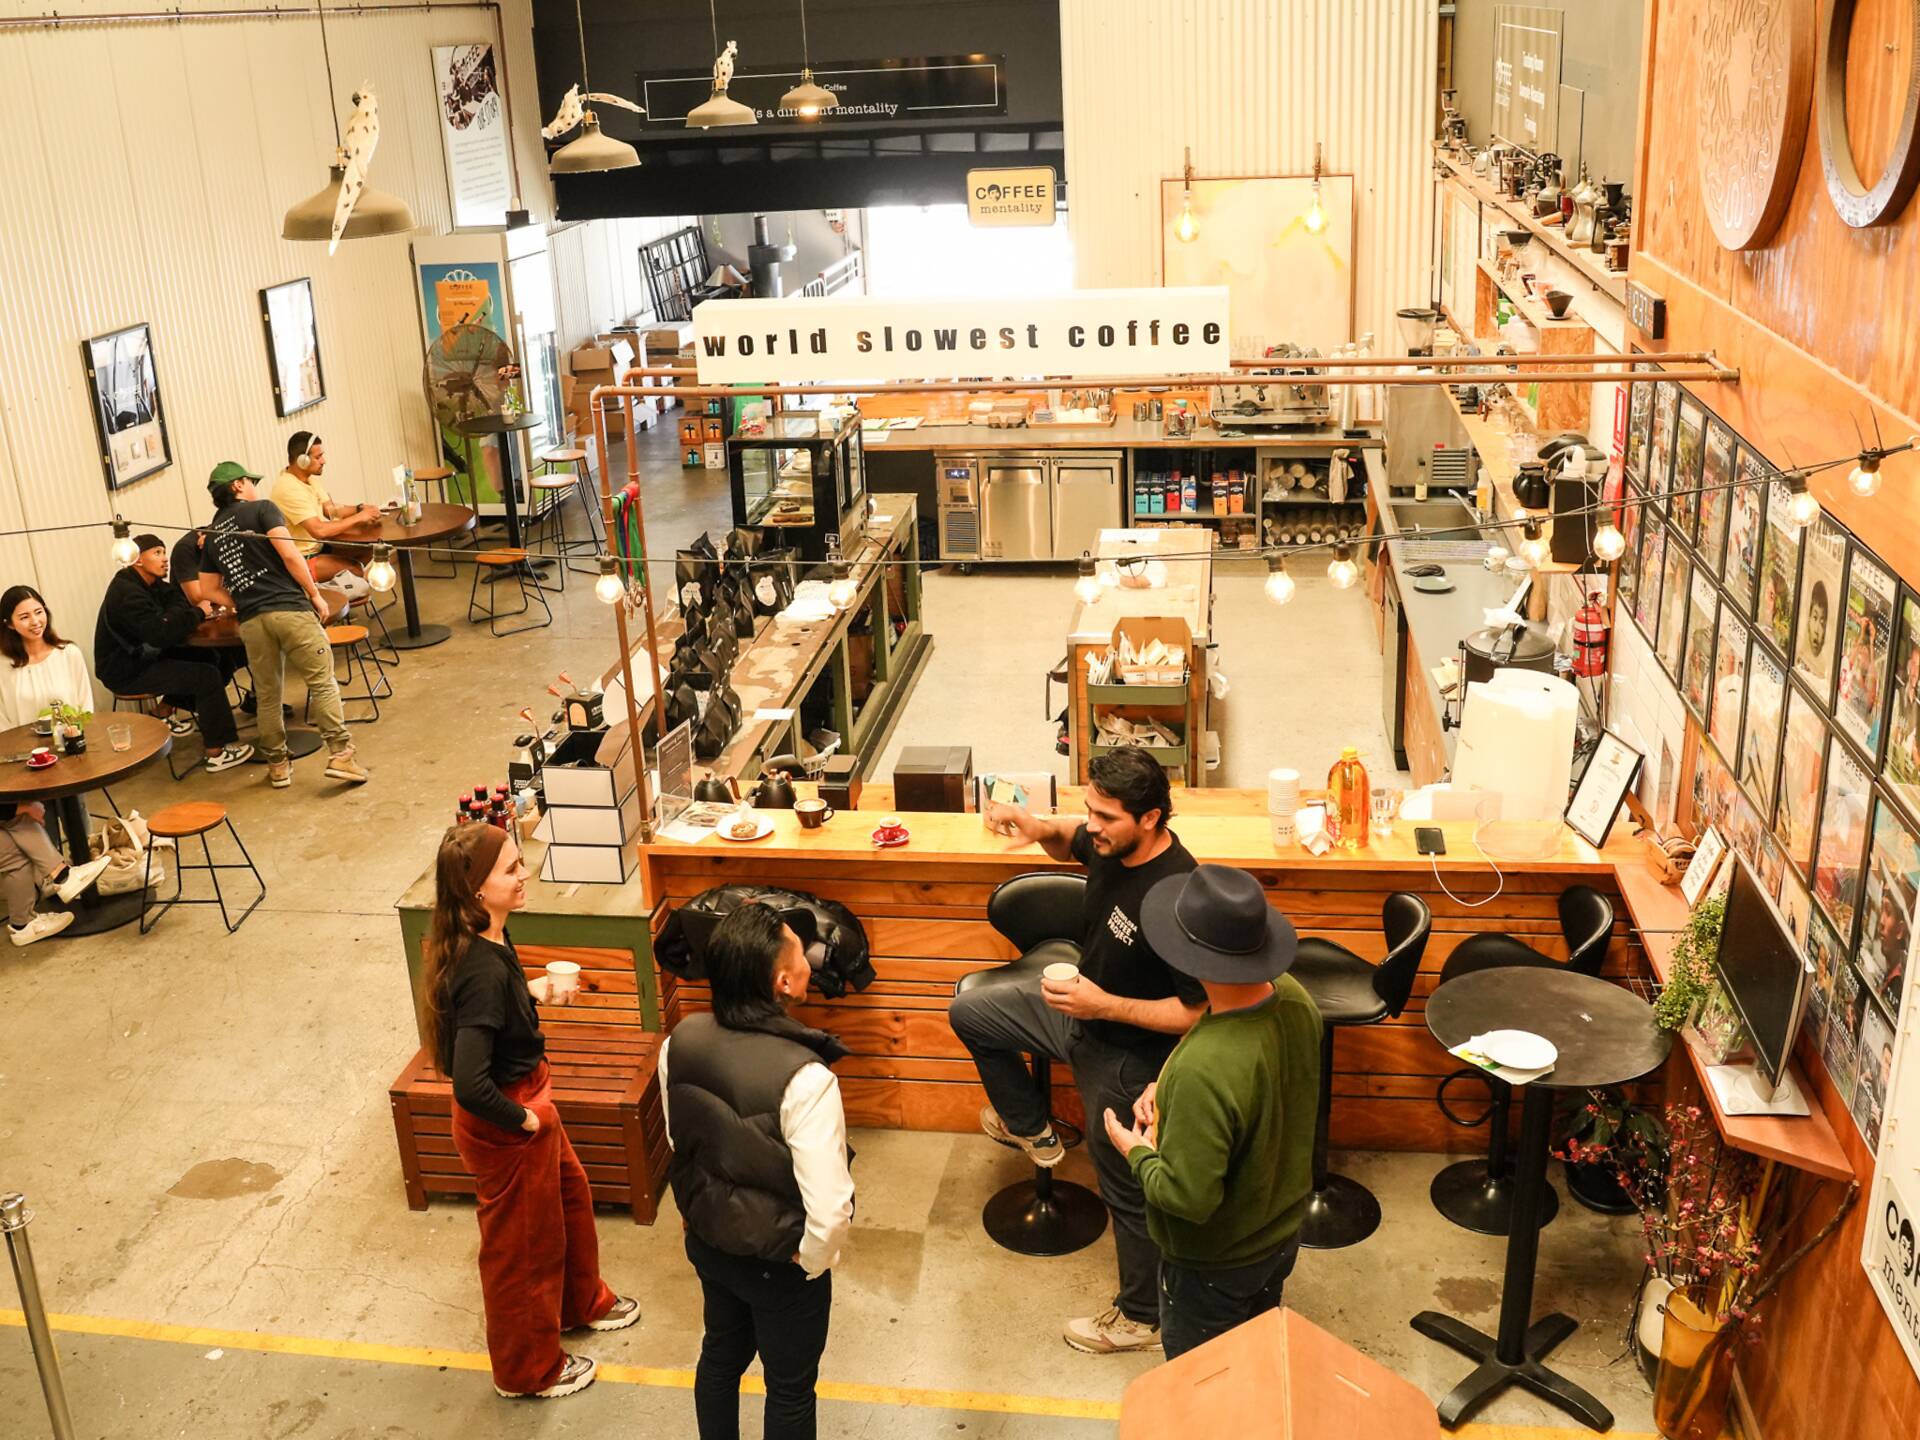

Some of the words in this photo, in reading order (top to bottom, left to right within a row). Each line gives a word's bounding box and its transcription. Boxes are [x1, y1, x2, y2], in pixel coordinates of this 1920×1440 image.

[766, 110, 774, 118] a
[836, 102, 898, 118] mentality
[975, 184, 1046, 202] COFFEE
[980, 203, 1042, 214] mentality
[703, 328, 827, 357] world
[856, 324, 1039, 352] slowest
[1068, 319, 1221, 348] coffee
